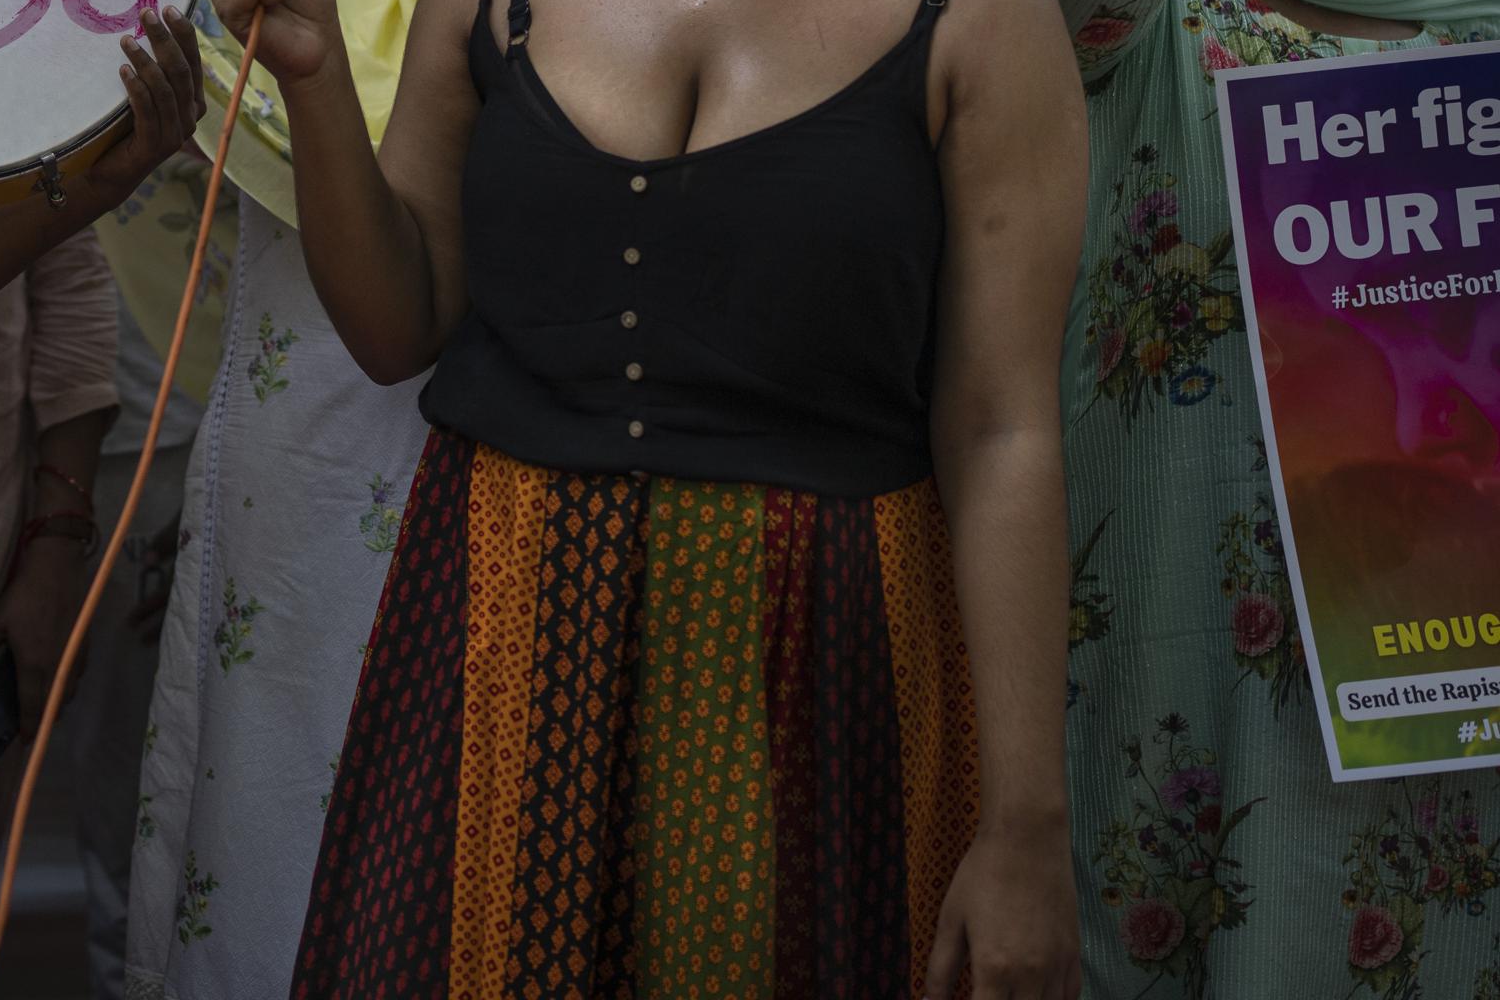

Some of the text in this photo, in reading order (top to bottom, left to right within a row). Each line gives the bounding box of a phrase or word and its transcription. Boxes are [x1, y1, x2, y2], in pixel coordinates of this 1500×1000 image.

[1261, 100, 1397, 165] Her
[1273, 192, 1443, 266] OUR
[1348, 677, 1500, 711] Send the Rapis
